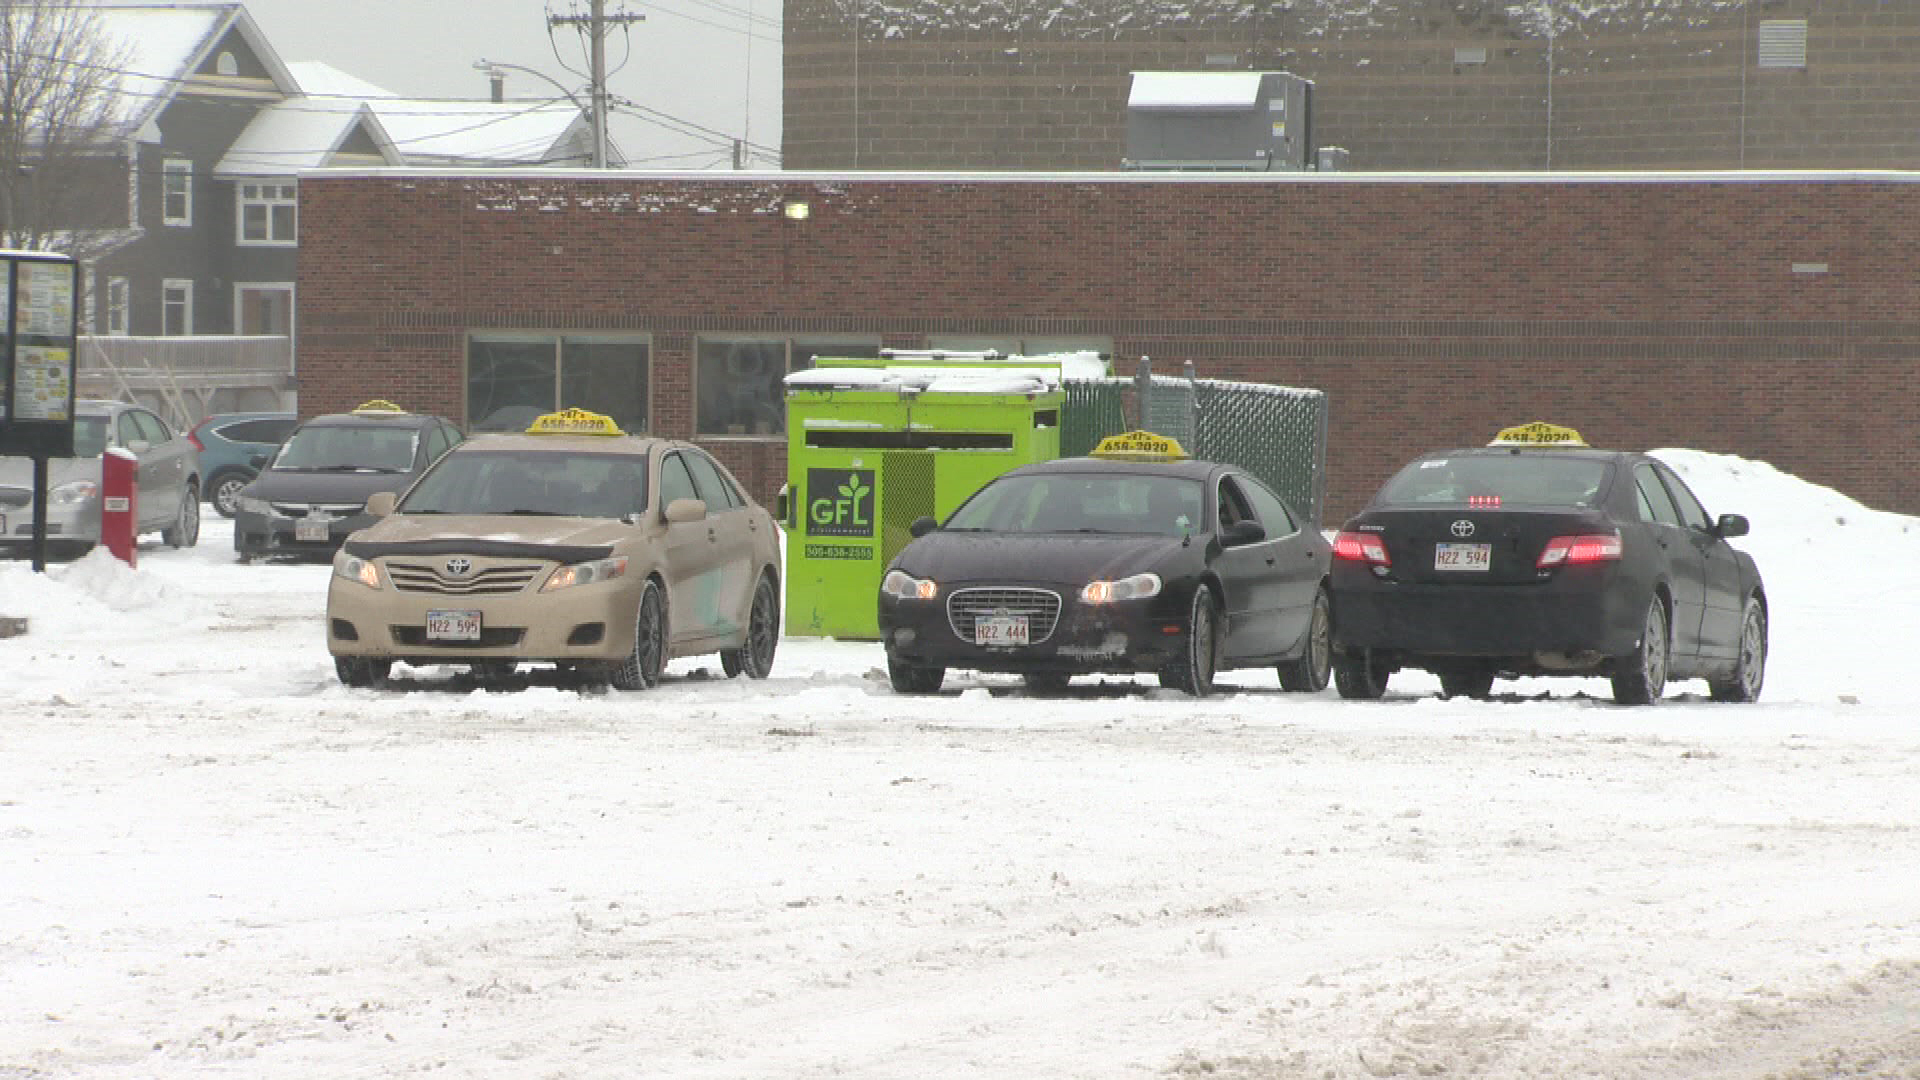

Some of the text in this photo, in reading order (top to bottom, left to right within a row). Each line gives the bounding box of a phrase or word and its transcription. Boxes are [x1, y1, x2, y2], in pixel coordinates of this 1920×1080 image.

[1104, 441, 1168, 453] 658-2020
[811, 486, 869, 525] GFL
[1437, 551, 1488, 565] H22 594
[429, 619, 478, 633] H22 595
[977, 625, 1026, 639] H22 444
